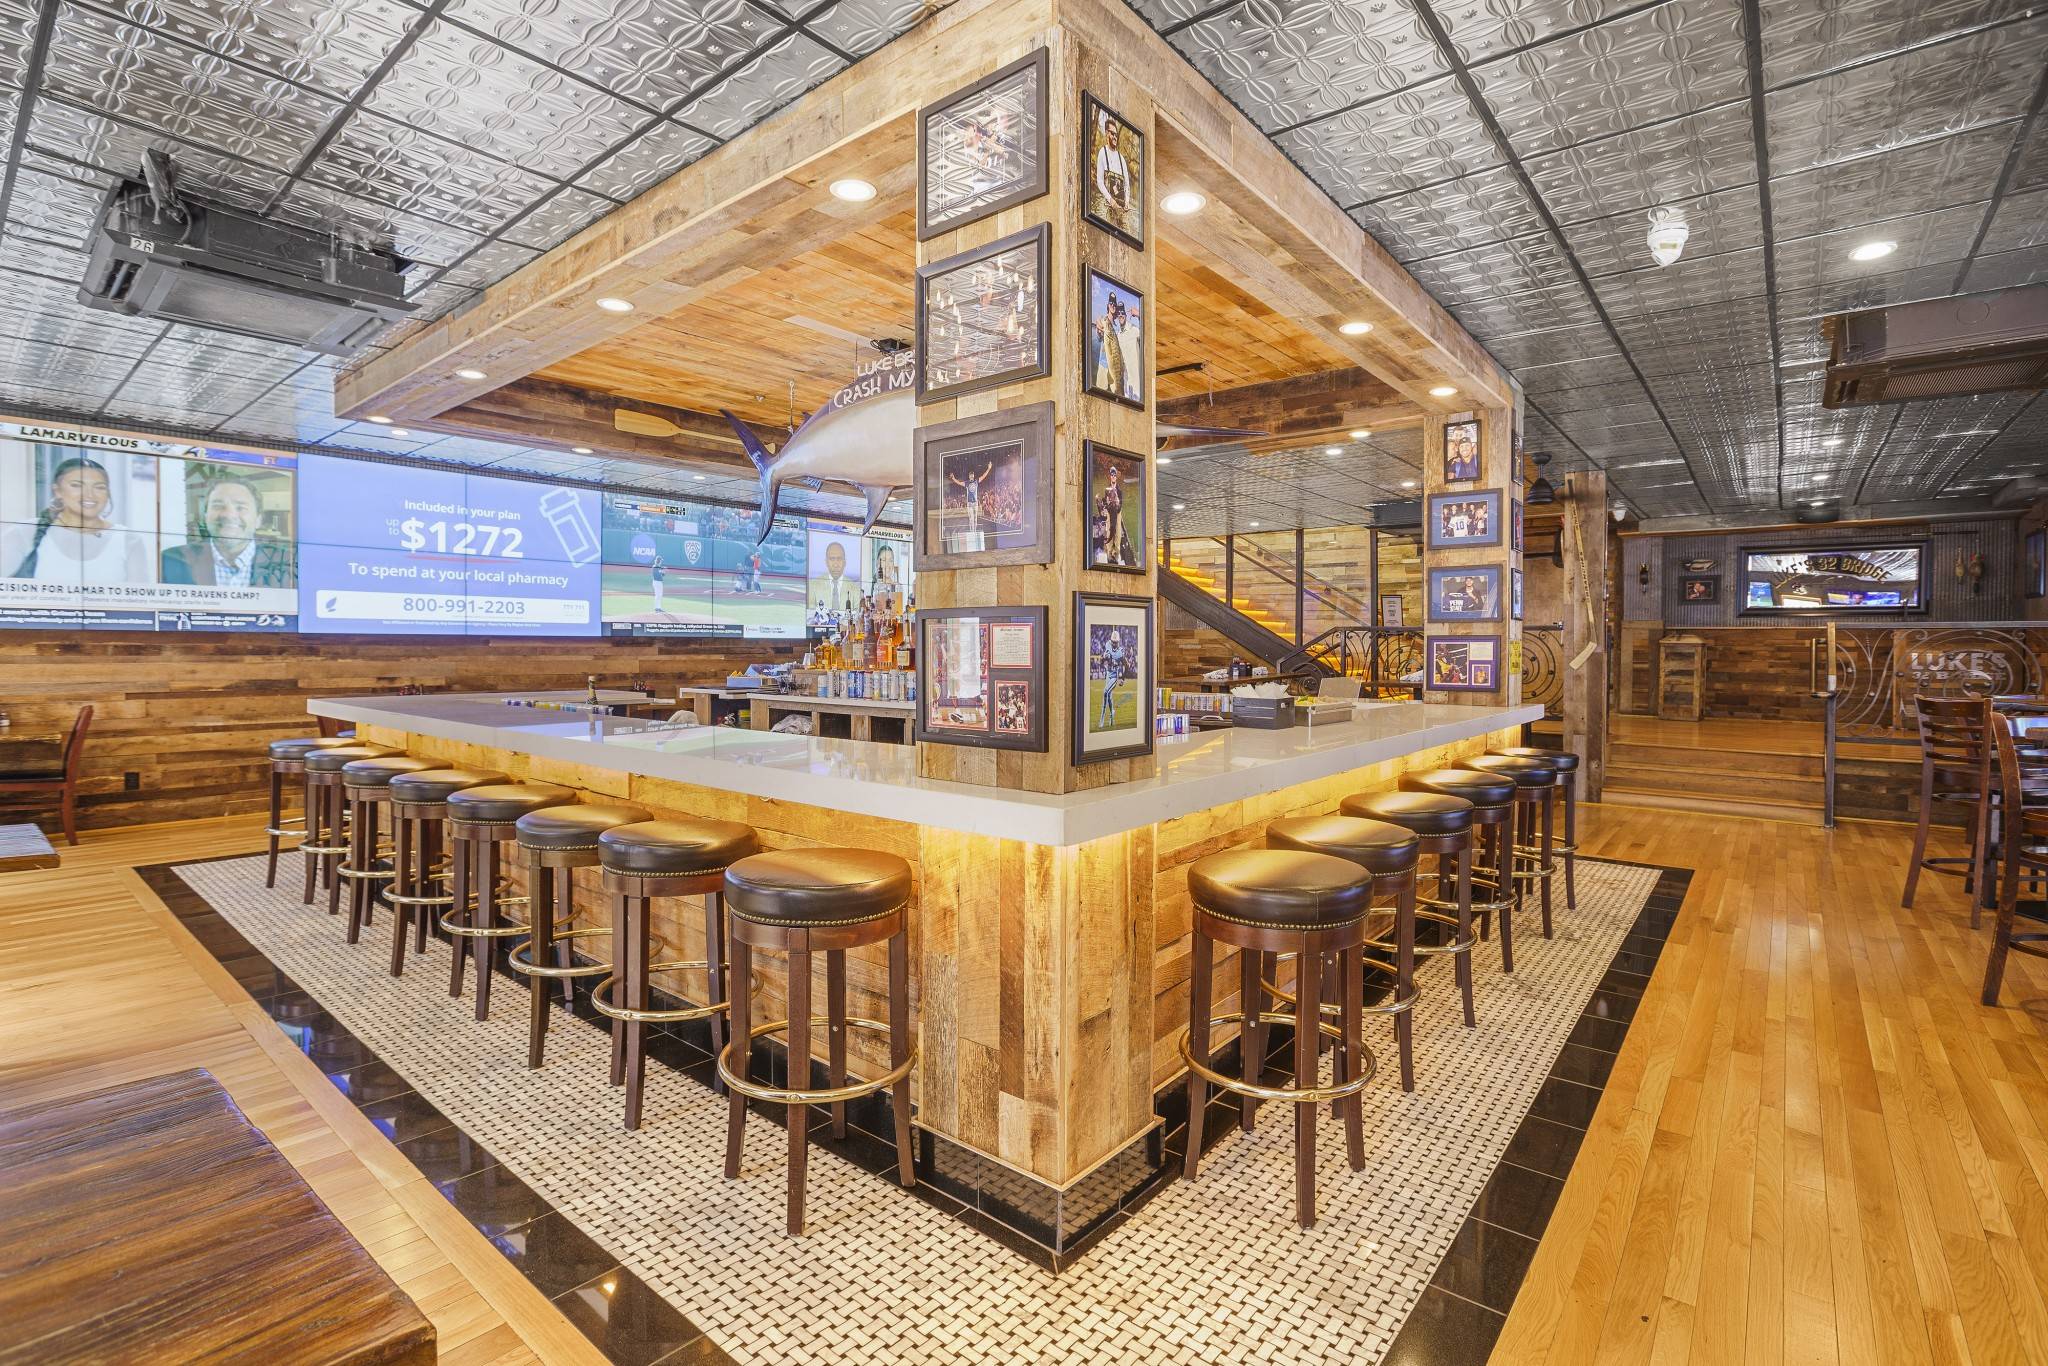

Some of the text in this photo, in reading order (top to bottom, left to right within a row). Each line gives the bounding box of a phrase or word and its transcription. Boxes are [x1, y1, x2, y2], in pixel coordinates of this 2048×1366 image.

[857, 350, 916, 377] LUKE BR
[833, 365, 916, 408] CRASH MY
[20, 426, 138, 448] LAMARVELOUS
[404, 500, 521, 521] Included in your plan
[386, 518, 400, 528] up
[388, 527, 400, 536] to
[400, 517, 524, 558] $1272
[632, 546, 657, 557] NCAA
[348, 562, 569, 588] To spend at your local pharmacy
[1771, 557, 1893, 585] UKE'S 32 BRIDGE
[42, 585, 64, 594] FOR
[67, 585, 105, 595] LAMAR
[108, 587, 122, 596] TO
[125, 587, 157, 597] SHOW
[159, 588, 173, 597] UP
[176, 589, 188, 598] TO
[190, 590, 228, 599] RAVENS
[403, 597, 526, 615] 800-991-2203
[1911, 652, 2006, 672] LUKE'S
